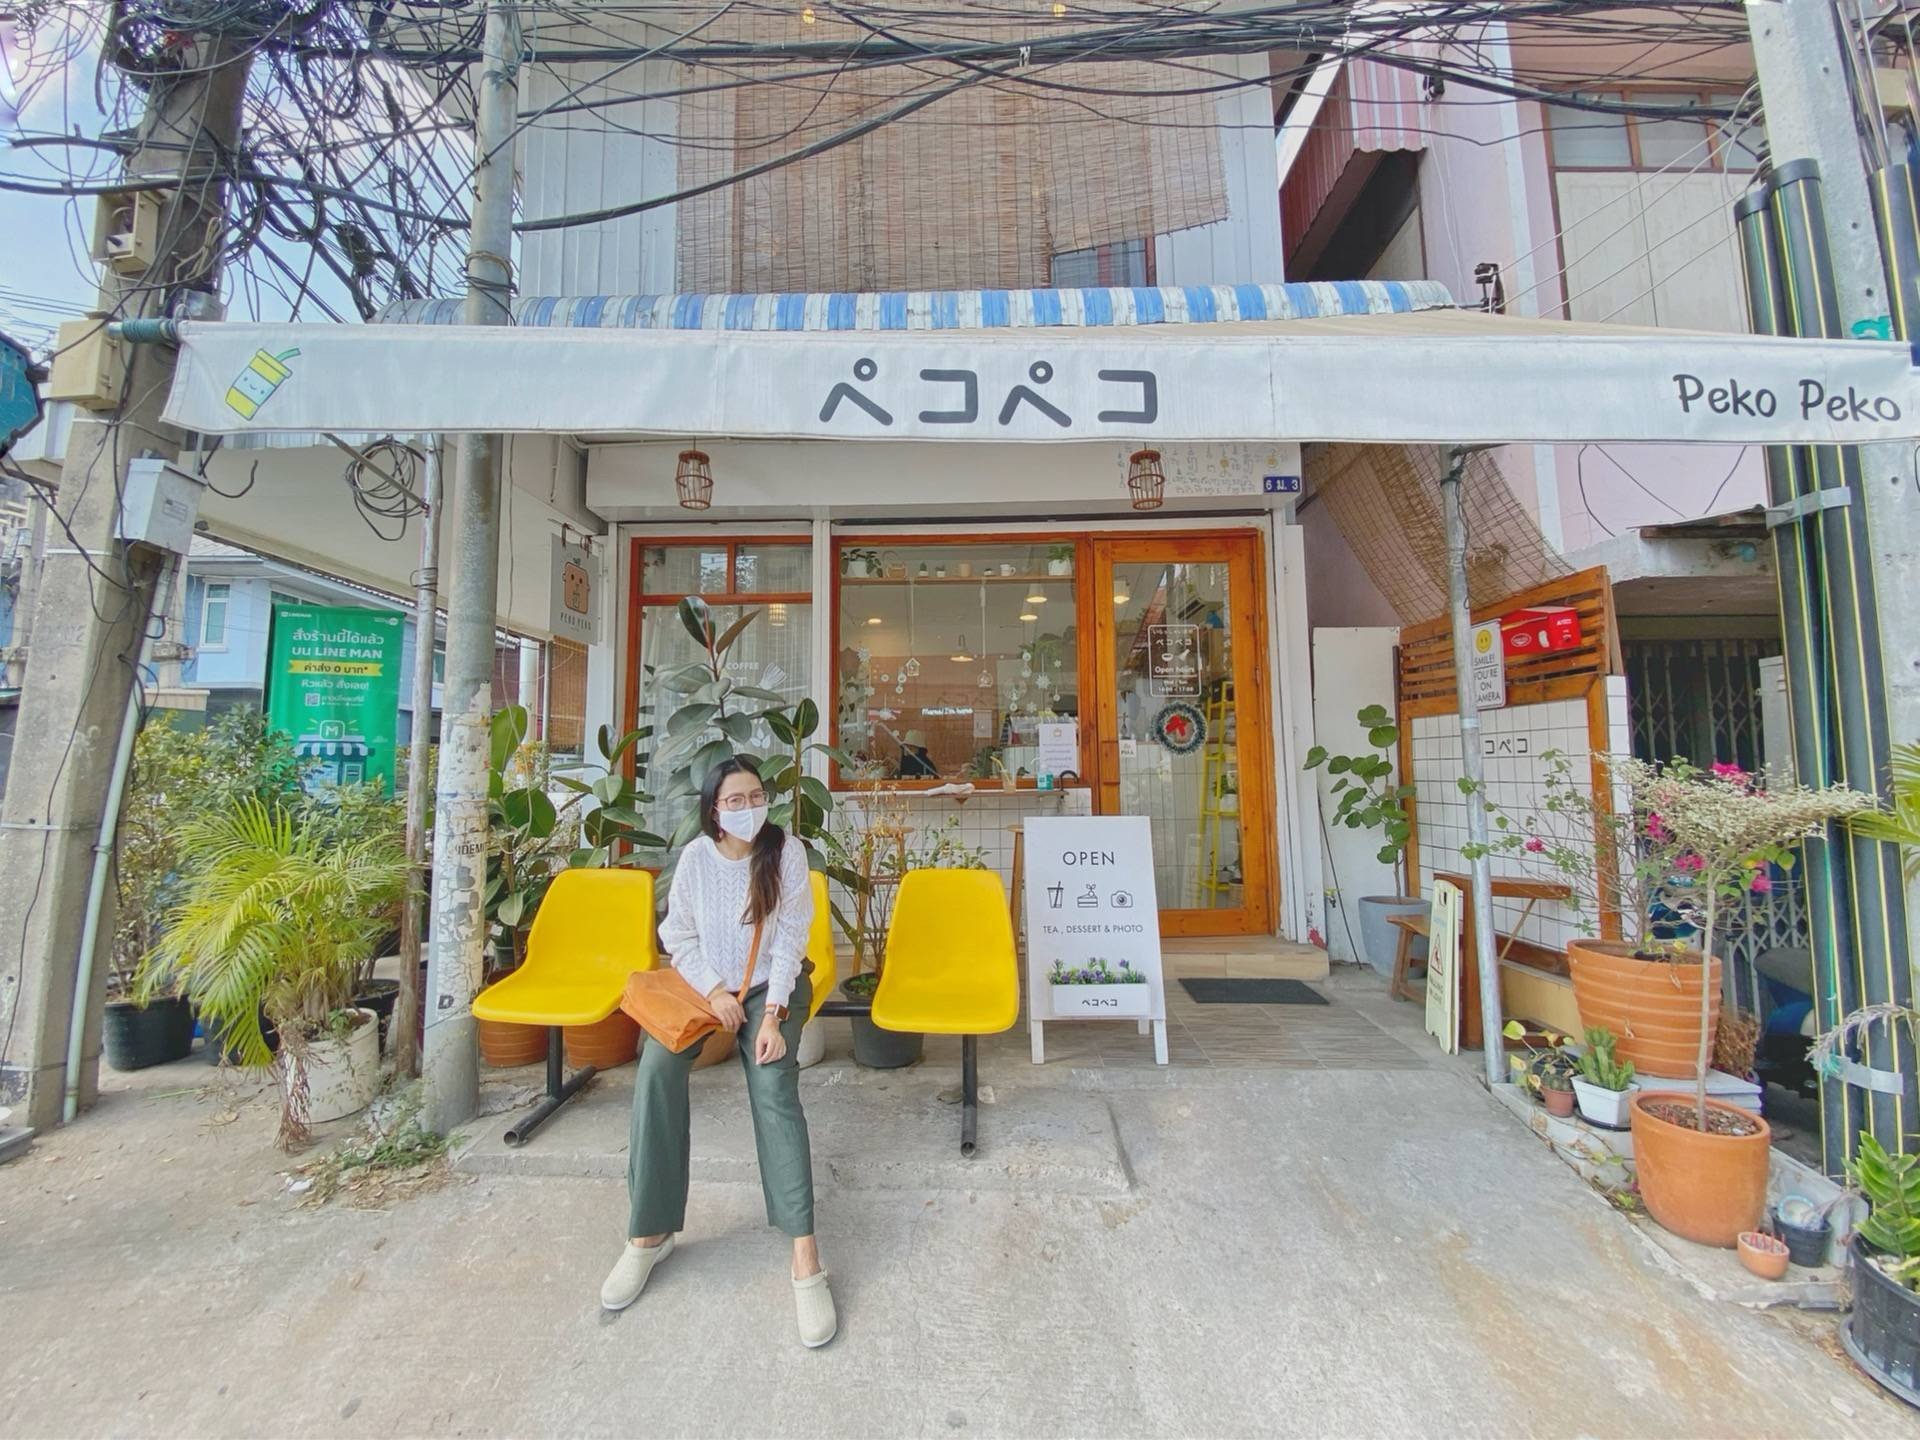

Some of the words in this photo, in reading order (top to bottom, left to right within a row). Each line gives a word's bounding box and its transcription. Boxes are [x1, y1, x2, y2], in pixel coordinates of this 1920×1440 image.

[819, 357, 1158, 428] ペコペコ
[1672, 374, 1777, 418] Peko
[1798, 379, 1902, 422] Peko
[1265, 479, 1273, 491] 6
[1291, 479, 1299, 491] 3
[292, 628, 385, 645] สั่งร้านนี้ได้แล้ว
[291, 646, 312, 656] บน
[314, 646, 347, 658] LINE
[349, 648, 383, 659] MAN
[1480, 680, 1492, 691] ON
[1477, 691, 1501, 702] AMERA
[1062, 851, 1115, 866] OPEN
[1043, 925, 1059, 934] TEA
[1066, 924, 1101, 934] DESSERT
[1104, 924, 1111, 934] &
[1112, 924, 1144, 933] PHOTO
